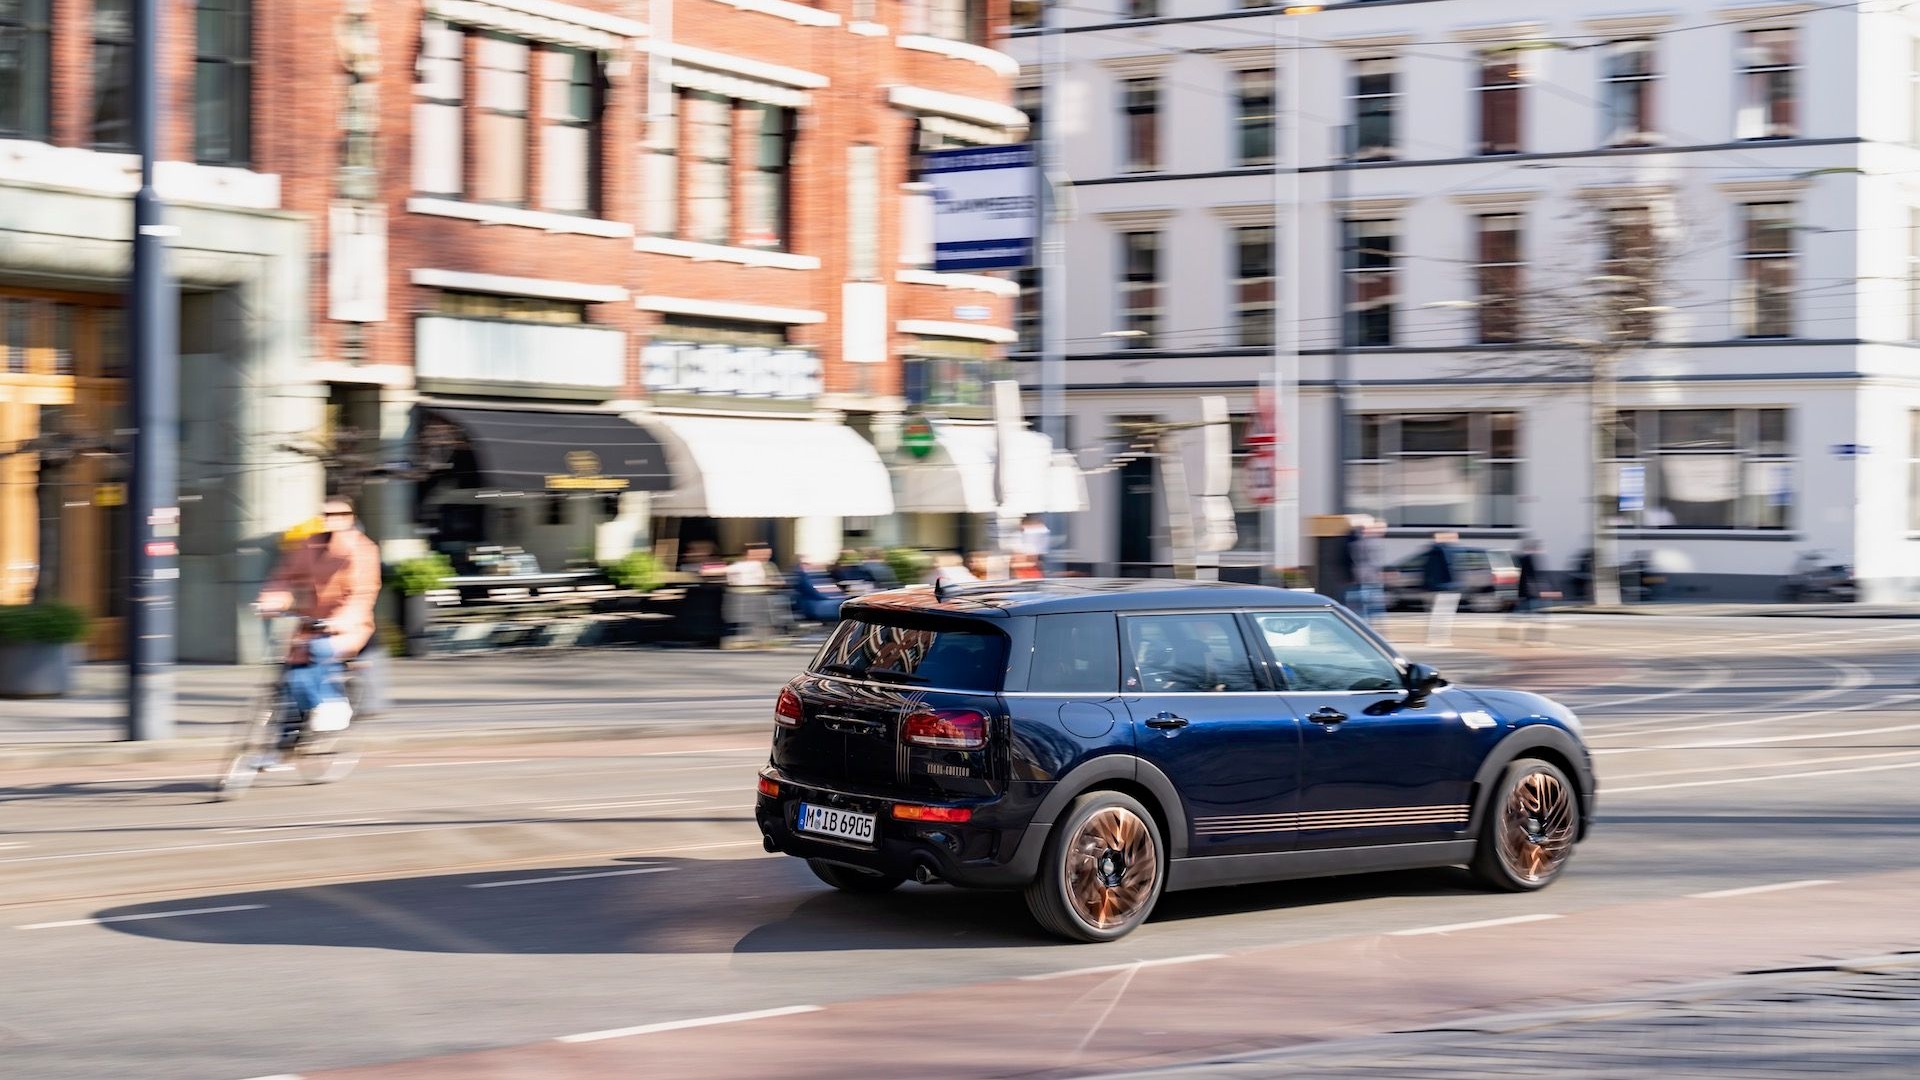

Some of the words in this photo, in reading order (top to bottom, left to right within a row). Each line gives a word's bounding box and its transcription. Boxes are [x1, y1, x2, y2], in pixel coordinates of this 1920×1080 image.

[806, 808, 815, 828] M
[822, 811, 838, 831] IB
[840, 814, 873, 837] 6905
